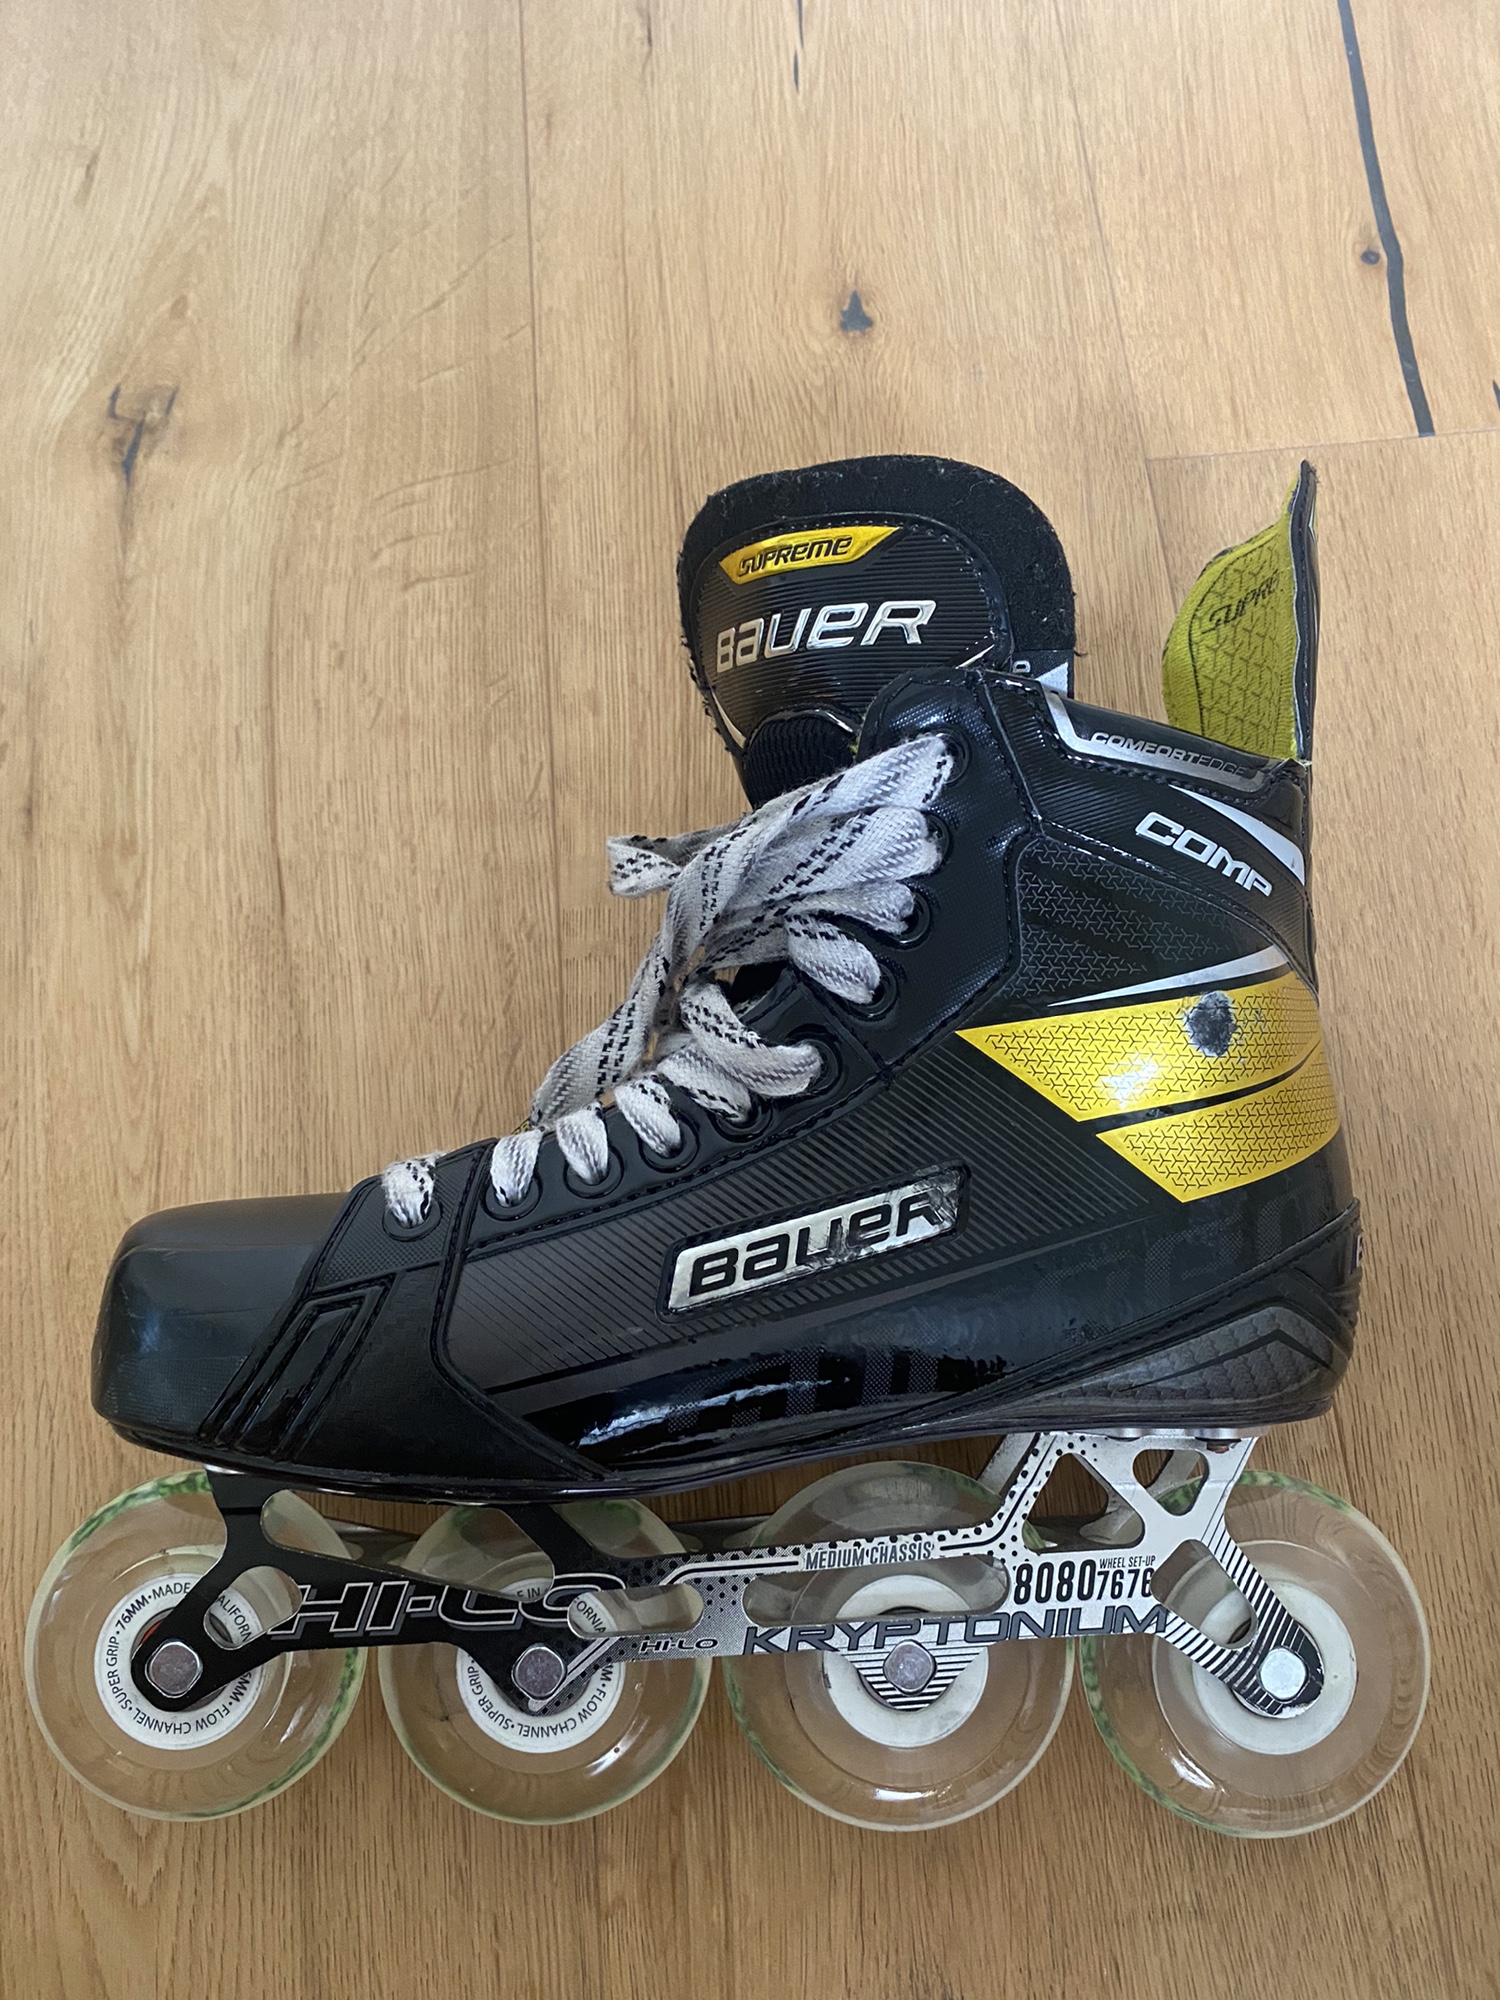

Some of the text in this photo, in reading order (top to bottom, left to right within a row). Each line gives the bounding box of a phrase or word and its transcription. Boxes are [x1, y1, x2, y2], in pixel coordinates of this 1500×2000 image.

[738, 535, 853, 578] SUPREME
[1135, 812, 1273, 897] COMP
[805, 1542, 932, 1570] MEDIUM CHASSIS
[1099, 1555, 1156, 1569] WHEEL SET-UP
[152, 1582, 191, 1600] MADE
[1013, 1559, 1097, 1605] 8080
[115, 1595, 150, 1631] 76MM
[743, 1603, 1169, 1656] KRYPTONIUM
[638, 1637, 720, 1653] HI-LO
[106, 1635, 133, 1710] SUPER GRIP
[132, 1704, 231, 1735] FLOW CHANNEL
[467, 1666, 513, 1730] SUPER GRIP
[517, 1687, 607, 1738] FLOW CHANNEL
